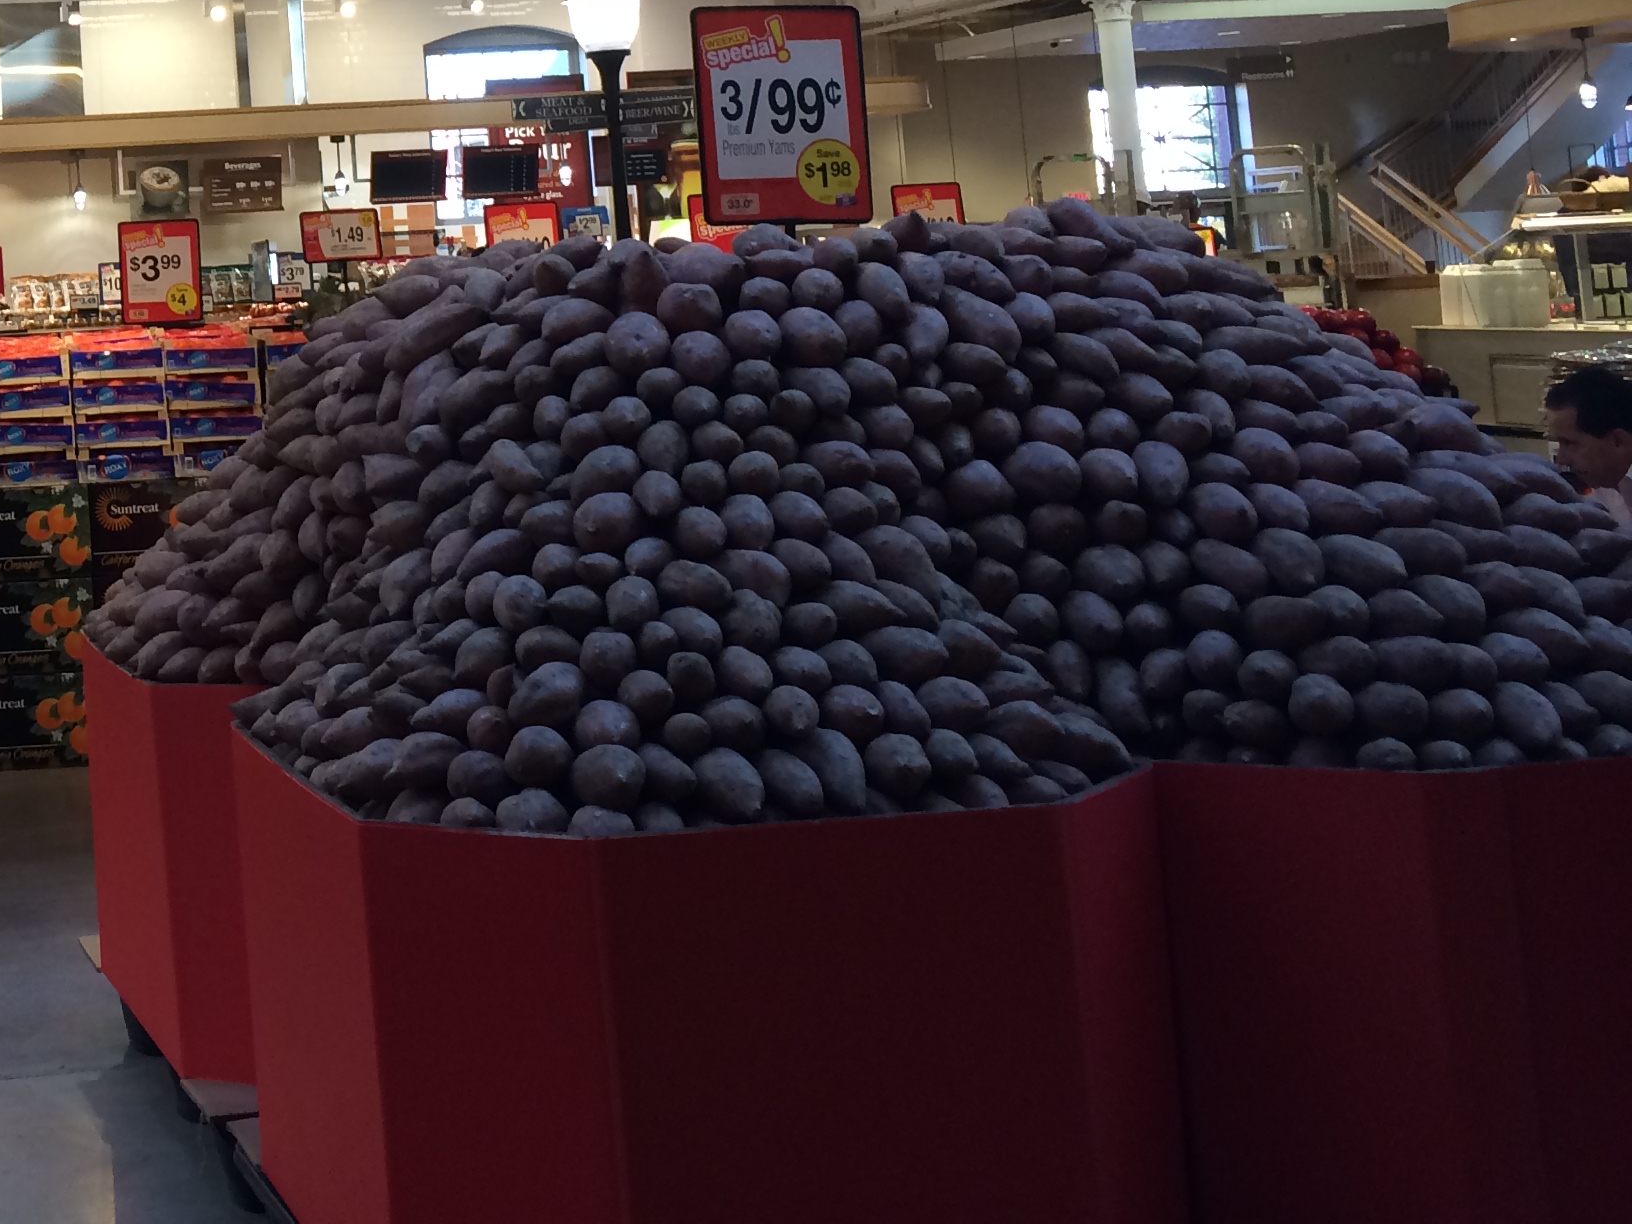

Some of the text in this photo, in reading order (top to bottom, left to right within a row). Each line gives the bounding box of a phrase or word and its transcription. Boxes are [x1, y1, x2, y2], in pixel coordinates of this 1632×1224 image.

[706, 32, 747, 49] WEEKLY
[541, 97, 585, 108] MEAT &
[535, 107, 592, 118] SEAFOOD
[625, 107, 681, 118] BEER/WINE
[722, 138, 796, 157] Premium Yams
[331, 226, 364, 243] $1.49
[7, 462, 31, 476] ROXY
[104, 461, 128, 475] ROXY
[110, 503, 160, 516] Suntreat
